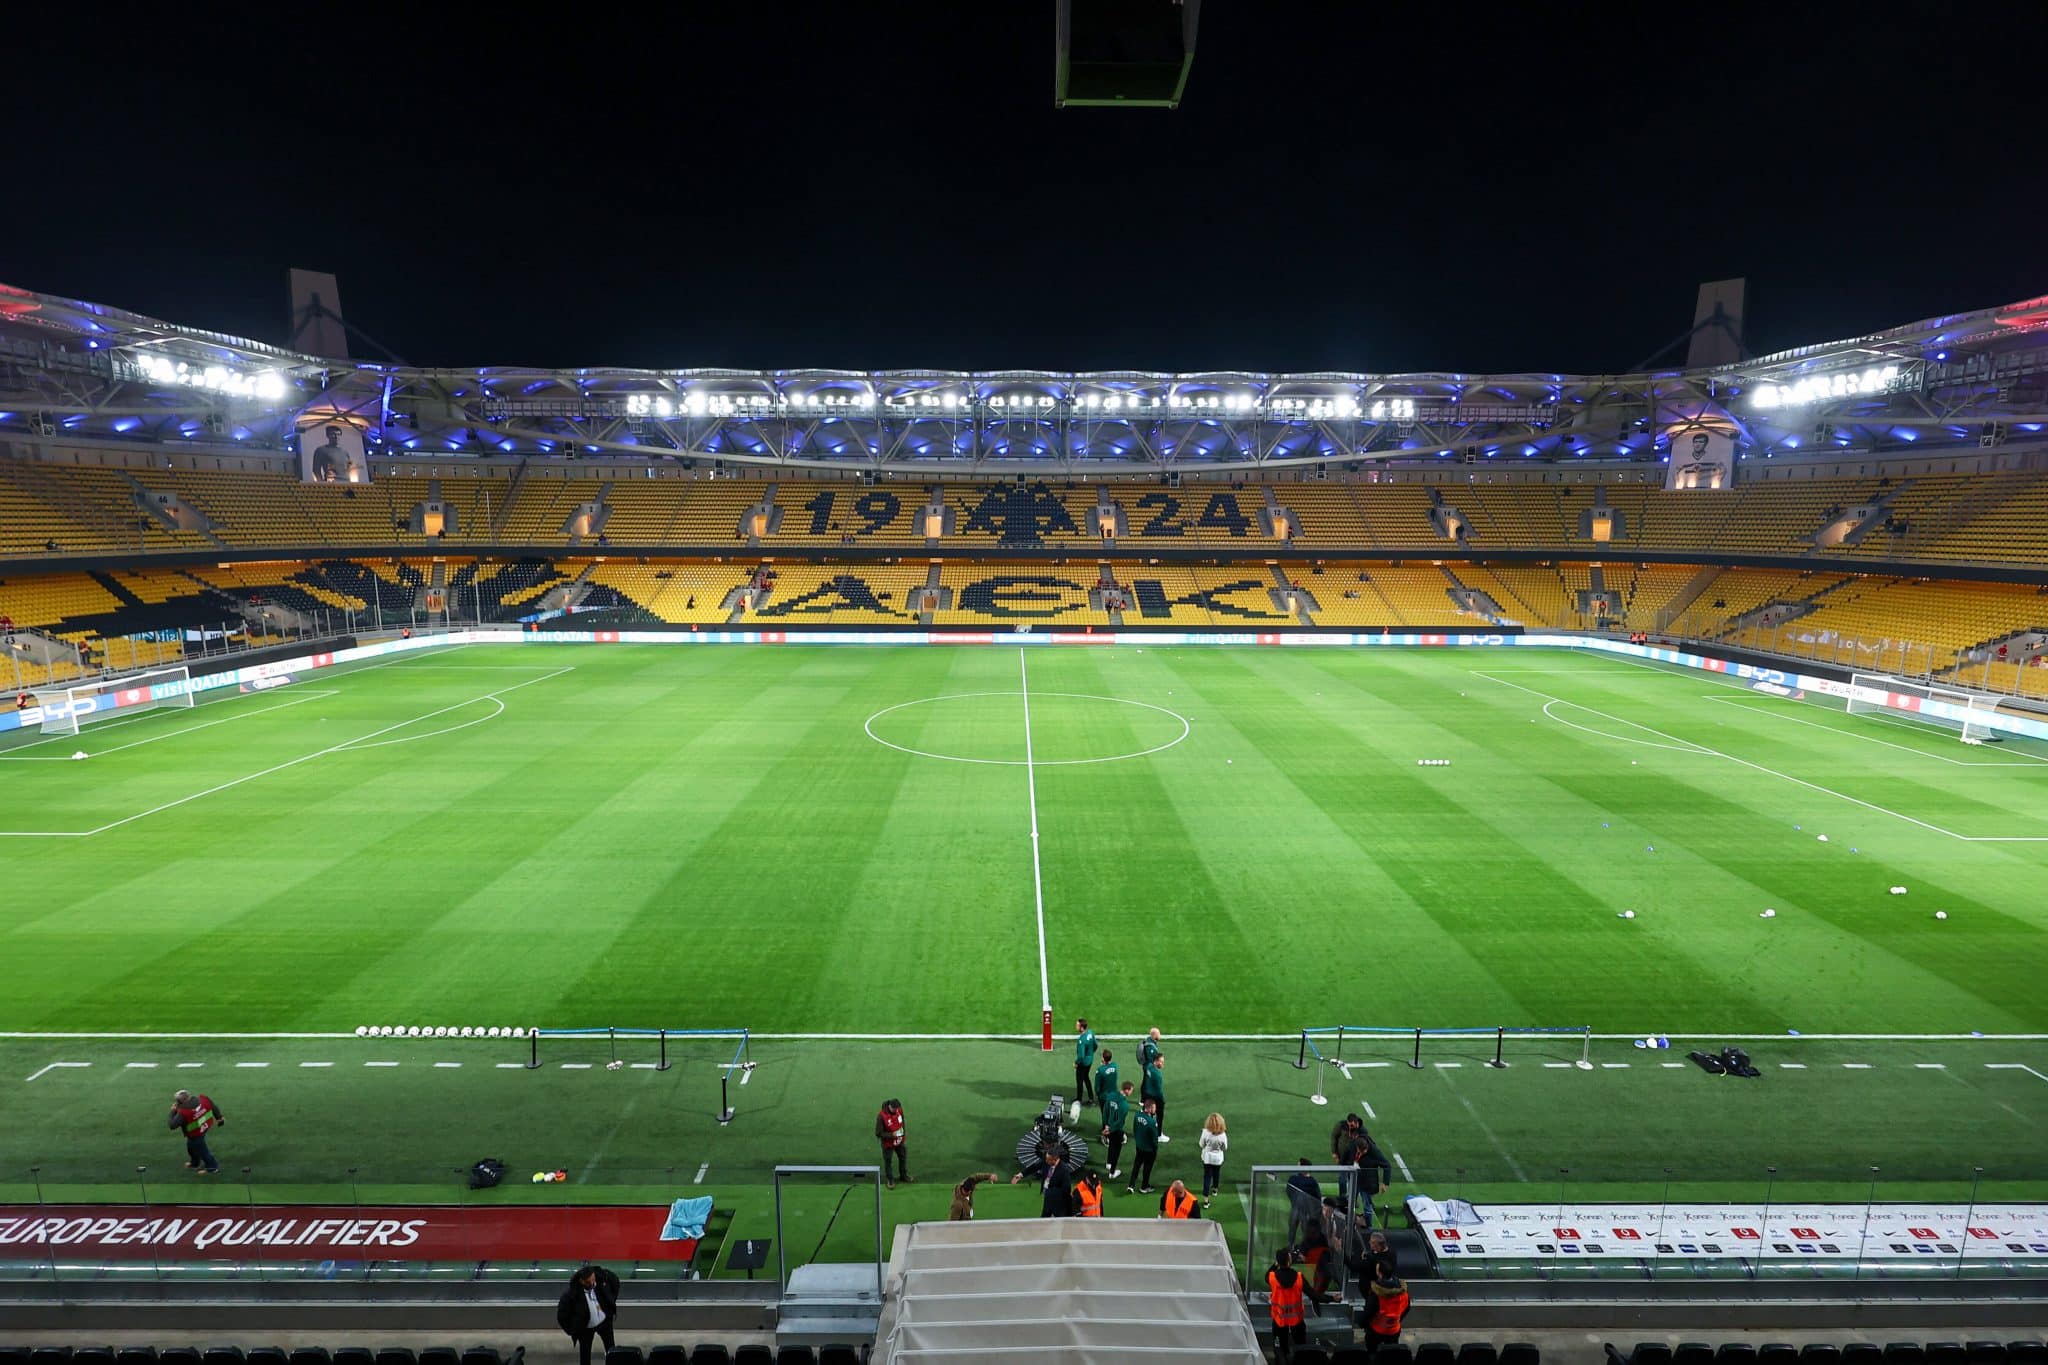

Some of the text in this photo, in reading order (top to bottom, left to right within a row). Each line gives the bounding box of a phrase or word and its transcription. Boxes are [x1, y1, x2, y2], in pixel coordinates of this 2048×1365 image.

[804, 491, 1252, 536] 19 24
[1458, 635, 1504, 645] BYD
[1737, 663, 1785, 684] BYD
[19, 698, 96, 727] BYD
[0, 1218, 427, 1249] EUROPEAN QUALIFIERS
